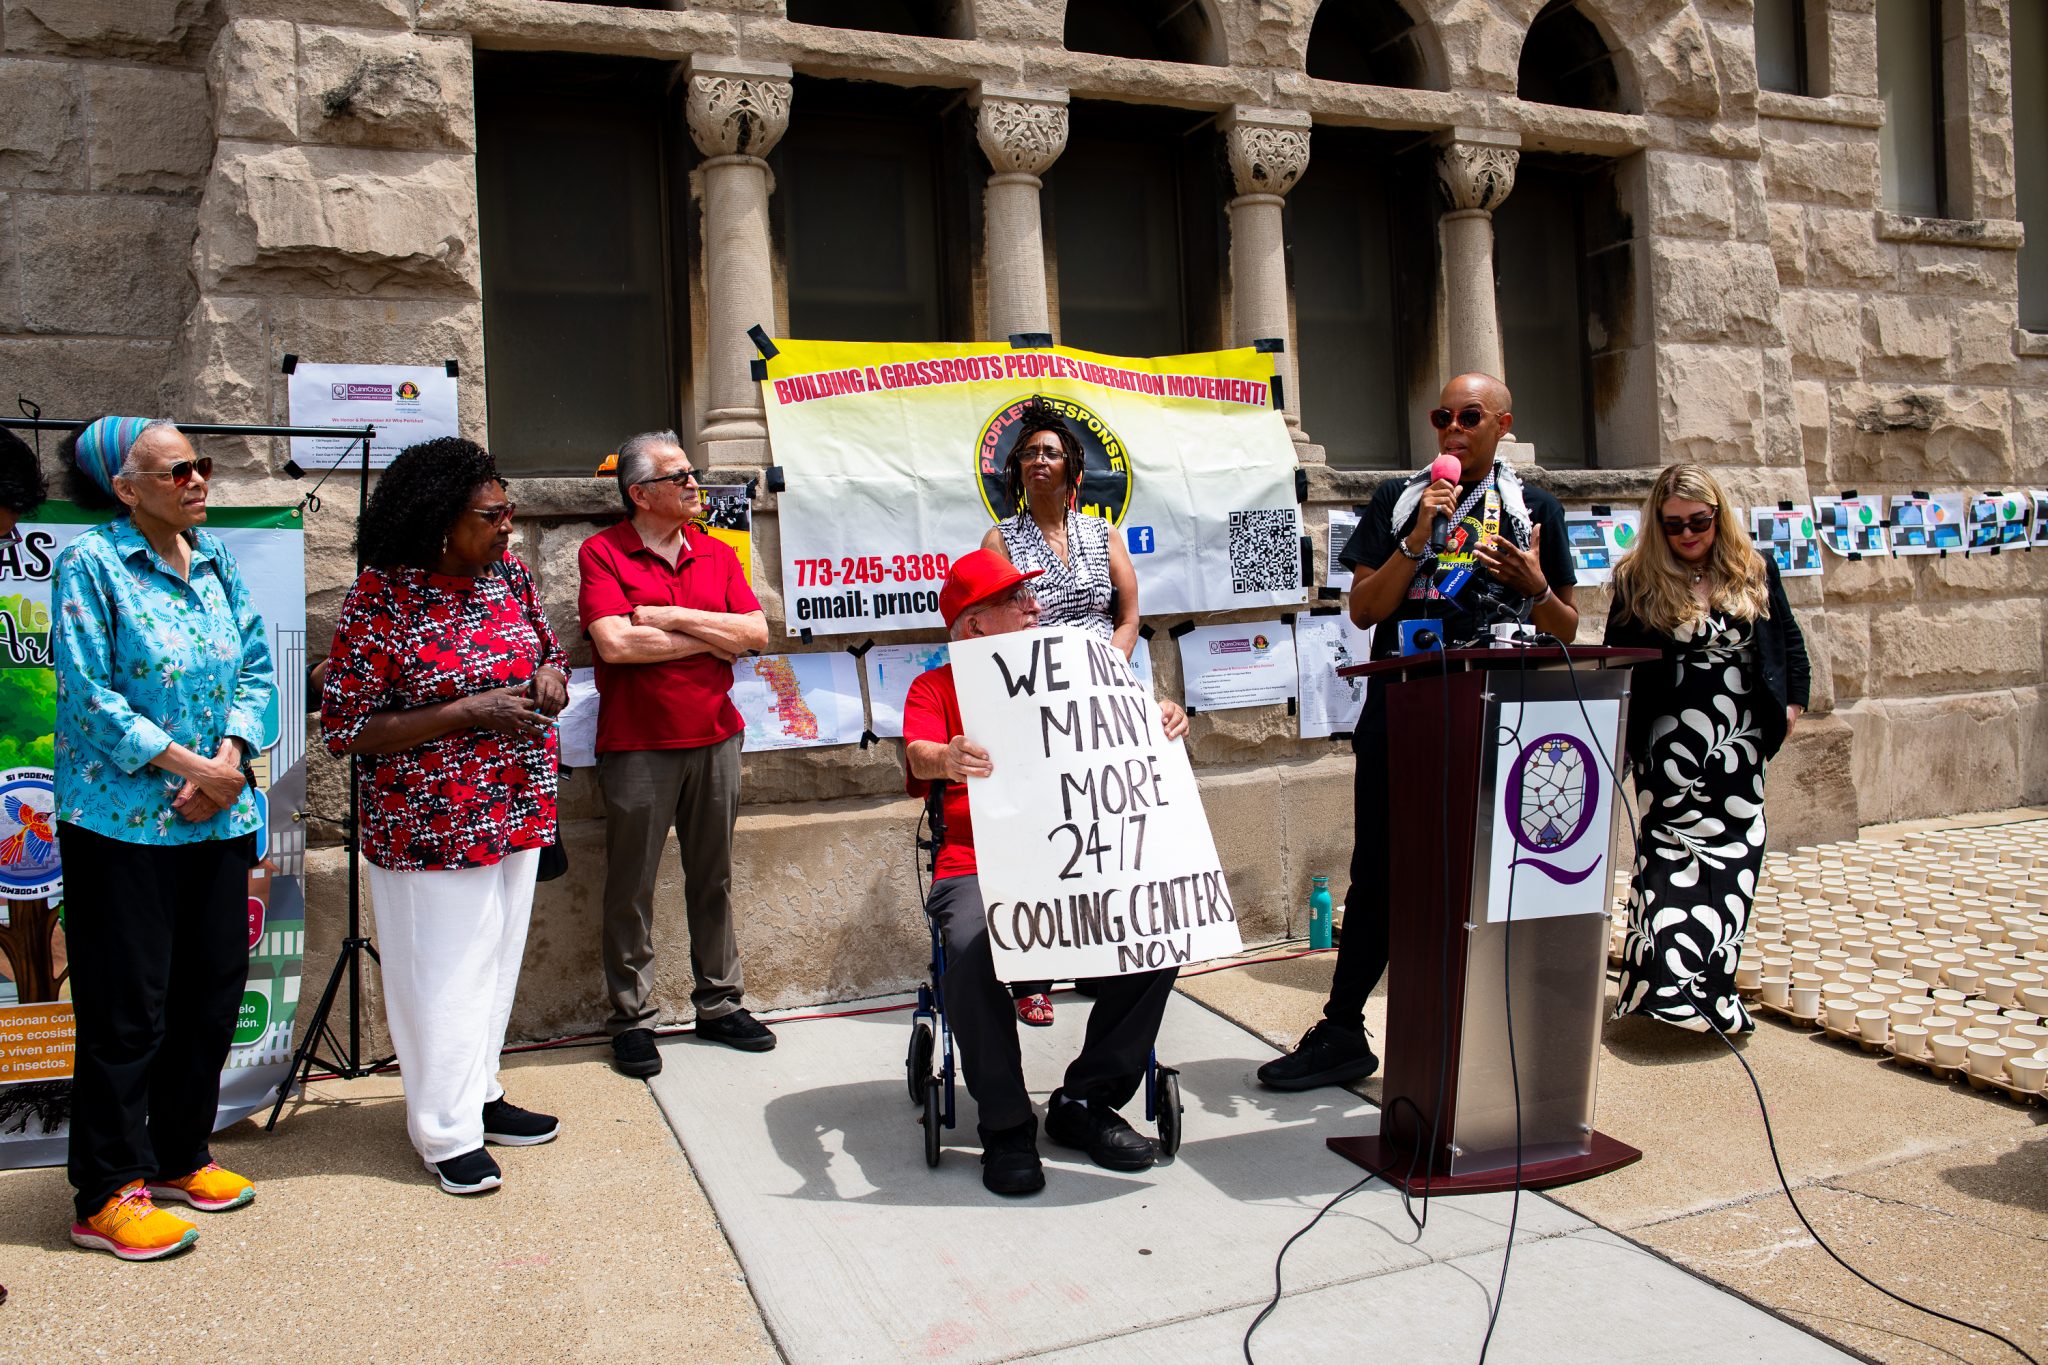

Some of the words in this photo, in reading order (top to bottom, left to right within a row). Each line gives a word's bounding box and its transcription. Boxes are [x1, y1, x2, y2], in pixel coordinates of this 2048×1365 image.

[774, 368, 865, 405] BUILDING
[866, 368, 881, 391] A
[881, 355, 1001, 389] GRASSROOTS
[1004, 354, 1079, 379] PEOPLE'S
[1078, 361, 1166, 396] LIBERATION
[1166, 375, 1268, 406] MOVEMENT!
[794, 553, 950, 587] 773-245-3389
[796, 590, 869, 621] email:
[872, 590, 940, 619] prnco
[991, 636, 1070, 698] WE
[1039, 696, 1152, 758] MANY
[1060, 755, 1169, 821] MORE
[1047, 813, 1147, 881] 24/7
[987, 888, 1127, 953] COOLING
[1128, 869, 1236, 938] CENTERS
[1117, 933, 1192, 973] NOW
[2, 1064, 9, 1073] e
[13, 1059, 70, 1072] insectos.
[8, 1046, 43, 1057] viven
